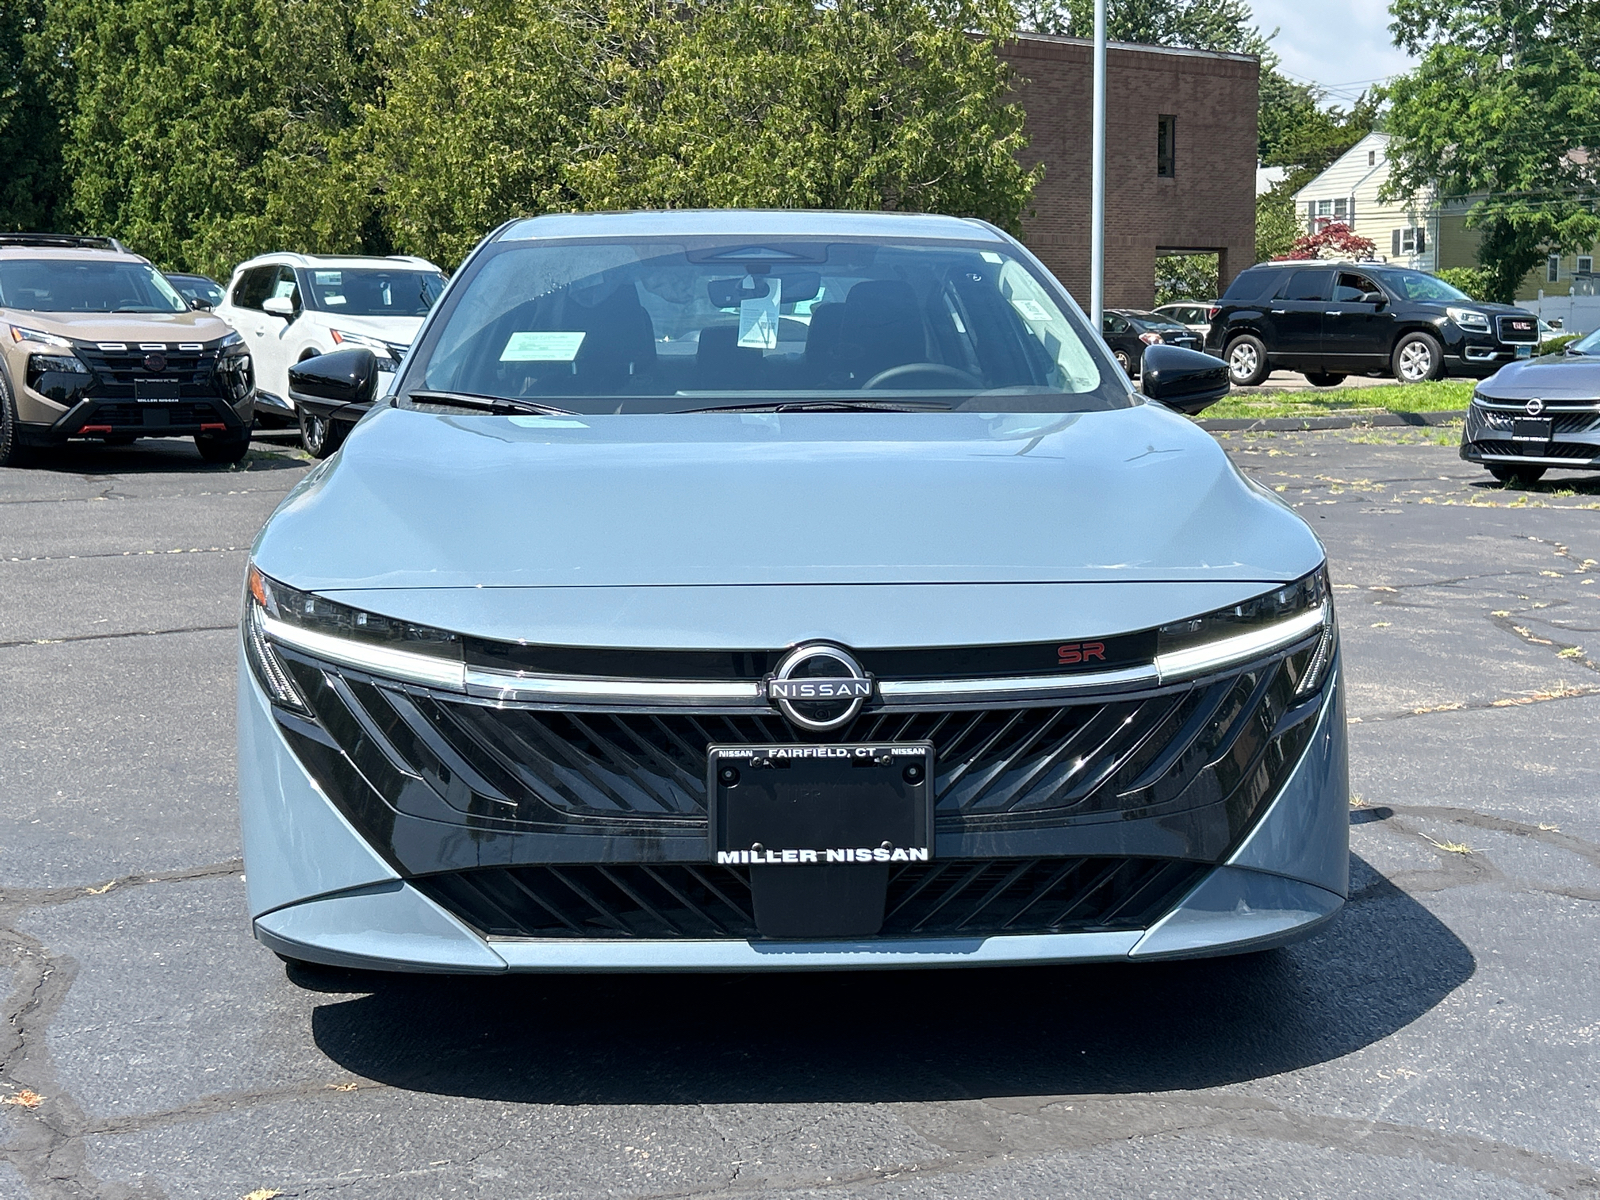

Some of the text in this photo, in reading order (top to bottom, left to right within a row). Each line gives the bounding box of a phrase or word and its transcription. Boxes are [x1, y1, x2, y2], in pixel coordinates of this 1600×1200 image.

[1057, 642, 1106, 665] SR
[772, 682, 870, 697] NISSAN
[718, 750, 753, 758] NISSAN
[768, 747, 877, 758] FAIRFIELD, CT
[891, 747, 926, 755] NISSAN
[717, 847, 928, 864] MILLER NISSAN
